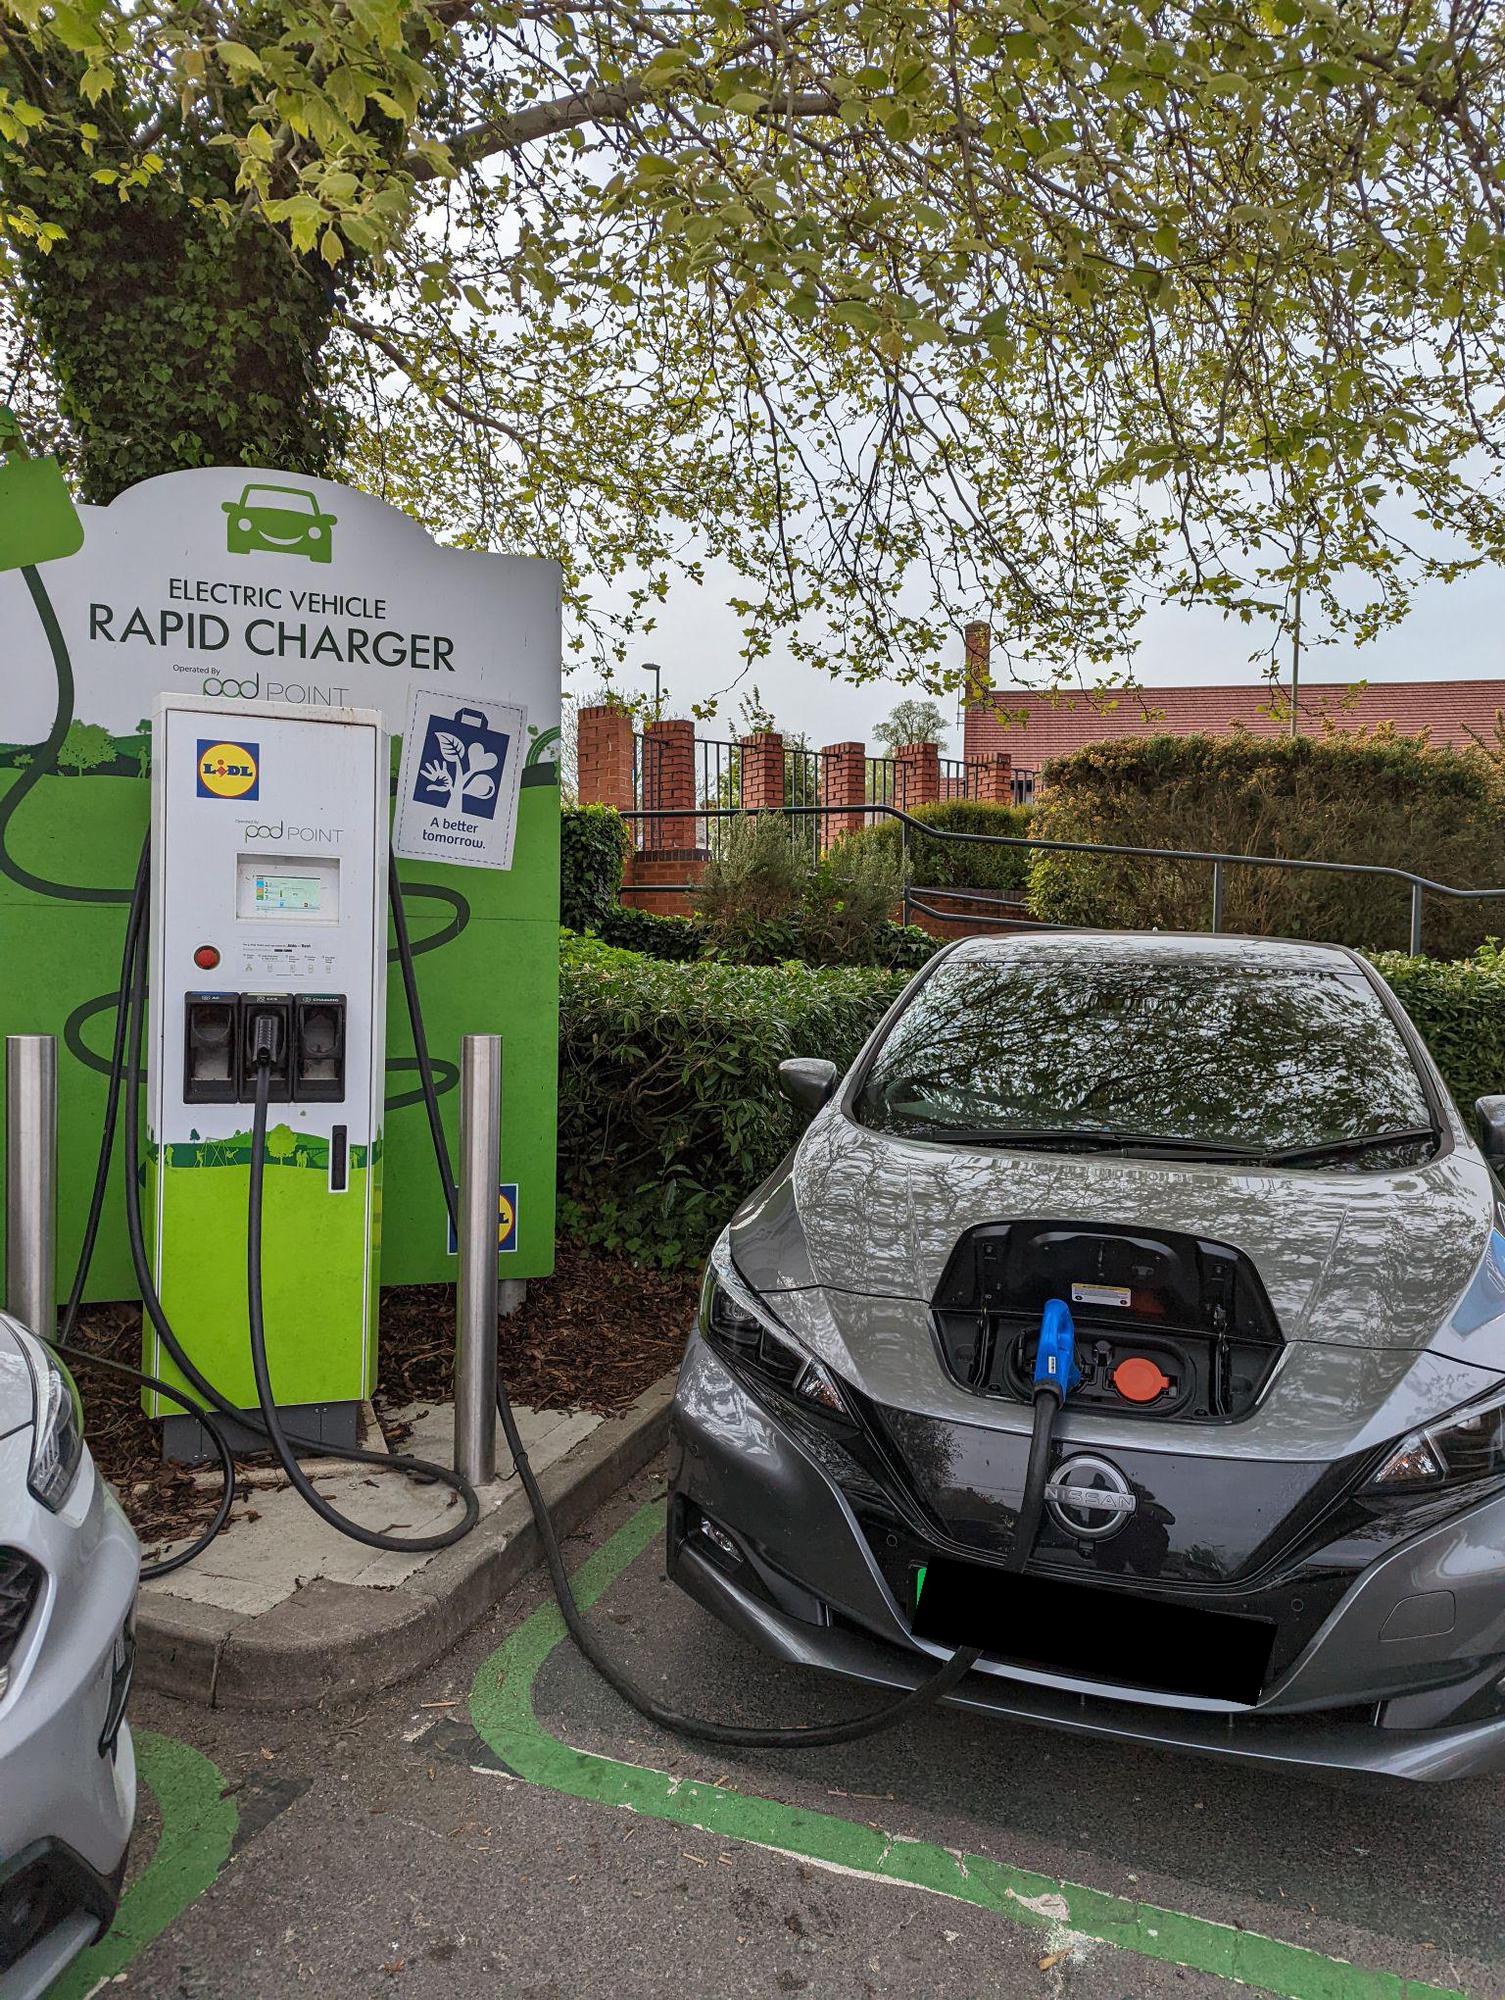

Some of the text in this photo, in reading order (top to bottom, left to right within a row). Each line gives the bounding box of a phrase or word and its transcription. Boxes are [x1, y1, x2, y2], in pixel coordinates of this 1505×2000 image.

[169, 578, 387, 619] ELECTRIC VEHICLE
[89, 602, 456, 672] RAPID CHARGER
[172, 663, 221, 676] Operated By
[203, 672, 350, 707] pod POINT
[245, 820, 284, 843] pod
[287, 827, 345, 843] POINT
[430, 817, 479, 833] A better
[422, 829, 486, 849] tomorrow.
[1045, 1486, 1134, 1511] NISSAN
